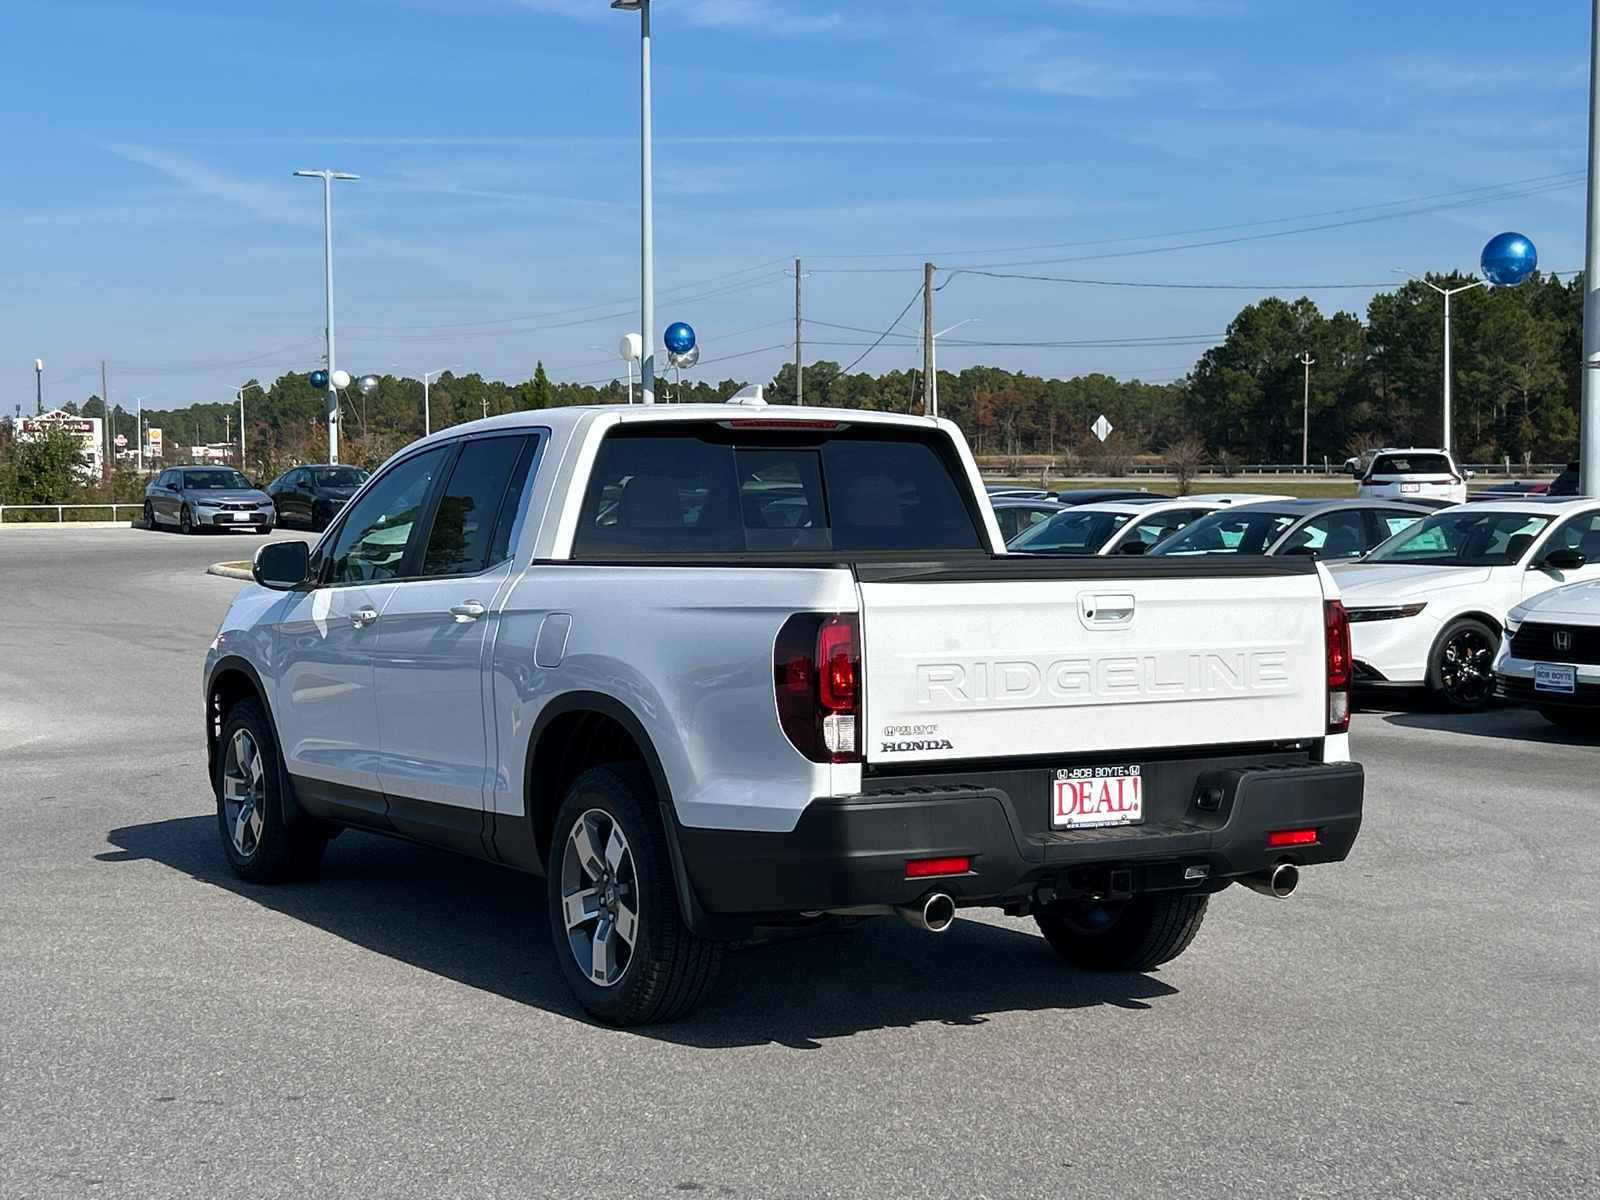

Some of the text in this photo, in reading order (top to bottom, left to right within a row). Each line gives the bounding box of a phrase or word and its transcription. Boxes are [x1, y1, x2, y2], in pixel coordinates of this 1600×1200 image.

[915, 650, 1289, 705] RIDGELINE
[1552, 672, 1572, 681] BOYTE
[880, 739, 954, 753] HONDA
[1073, 768, 1093, 778] BOB
[1095, 766, 1125, 777] BOYTE
[1056, 777, 1139, 816] DEAL!
